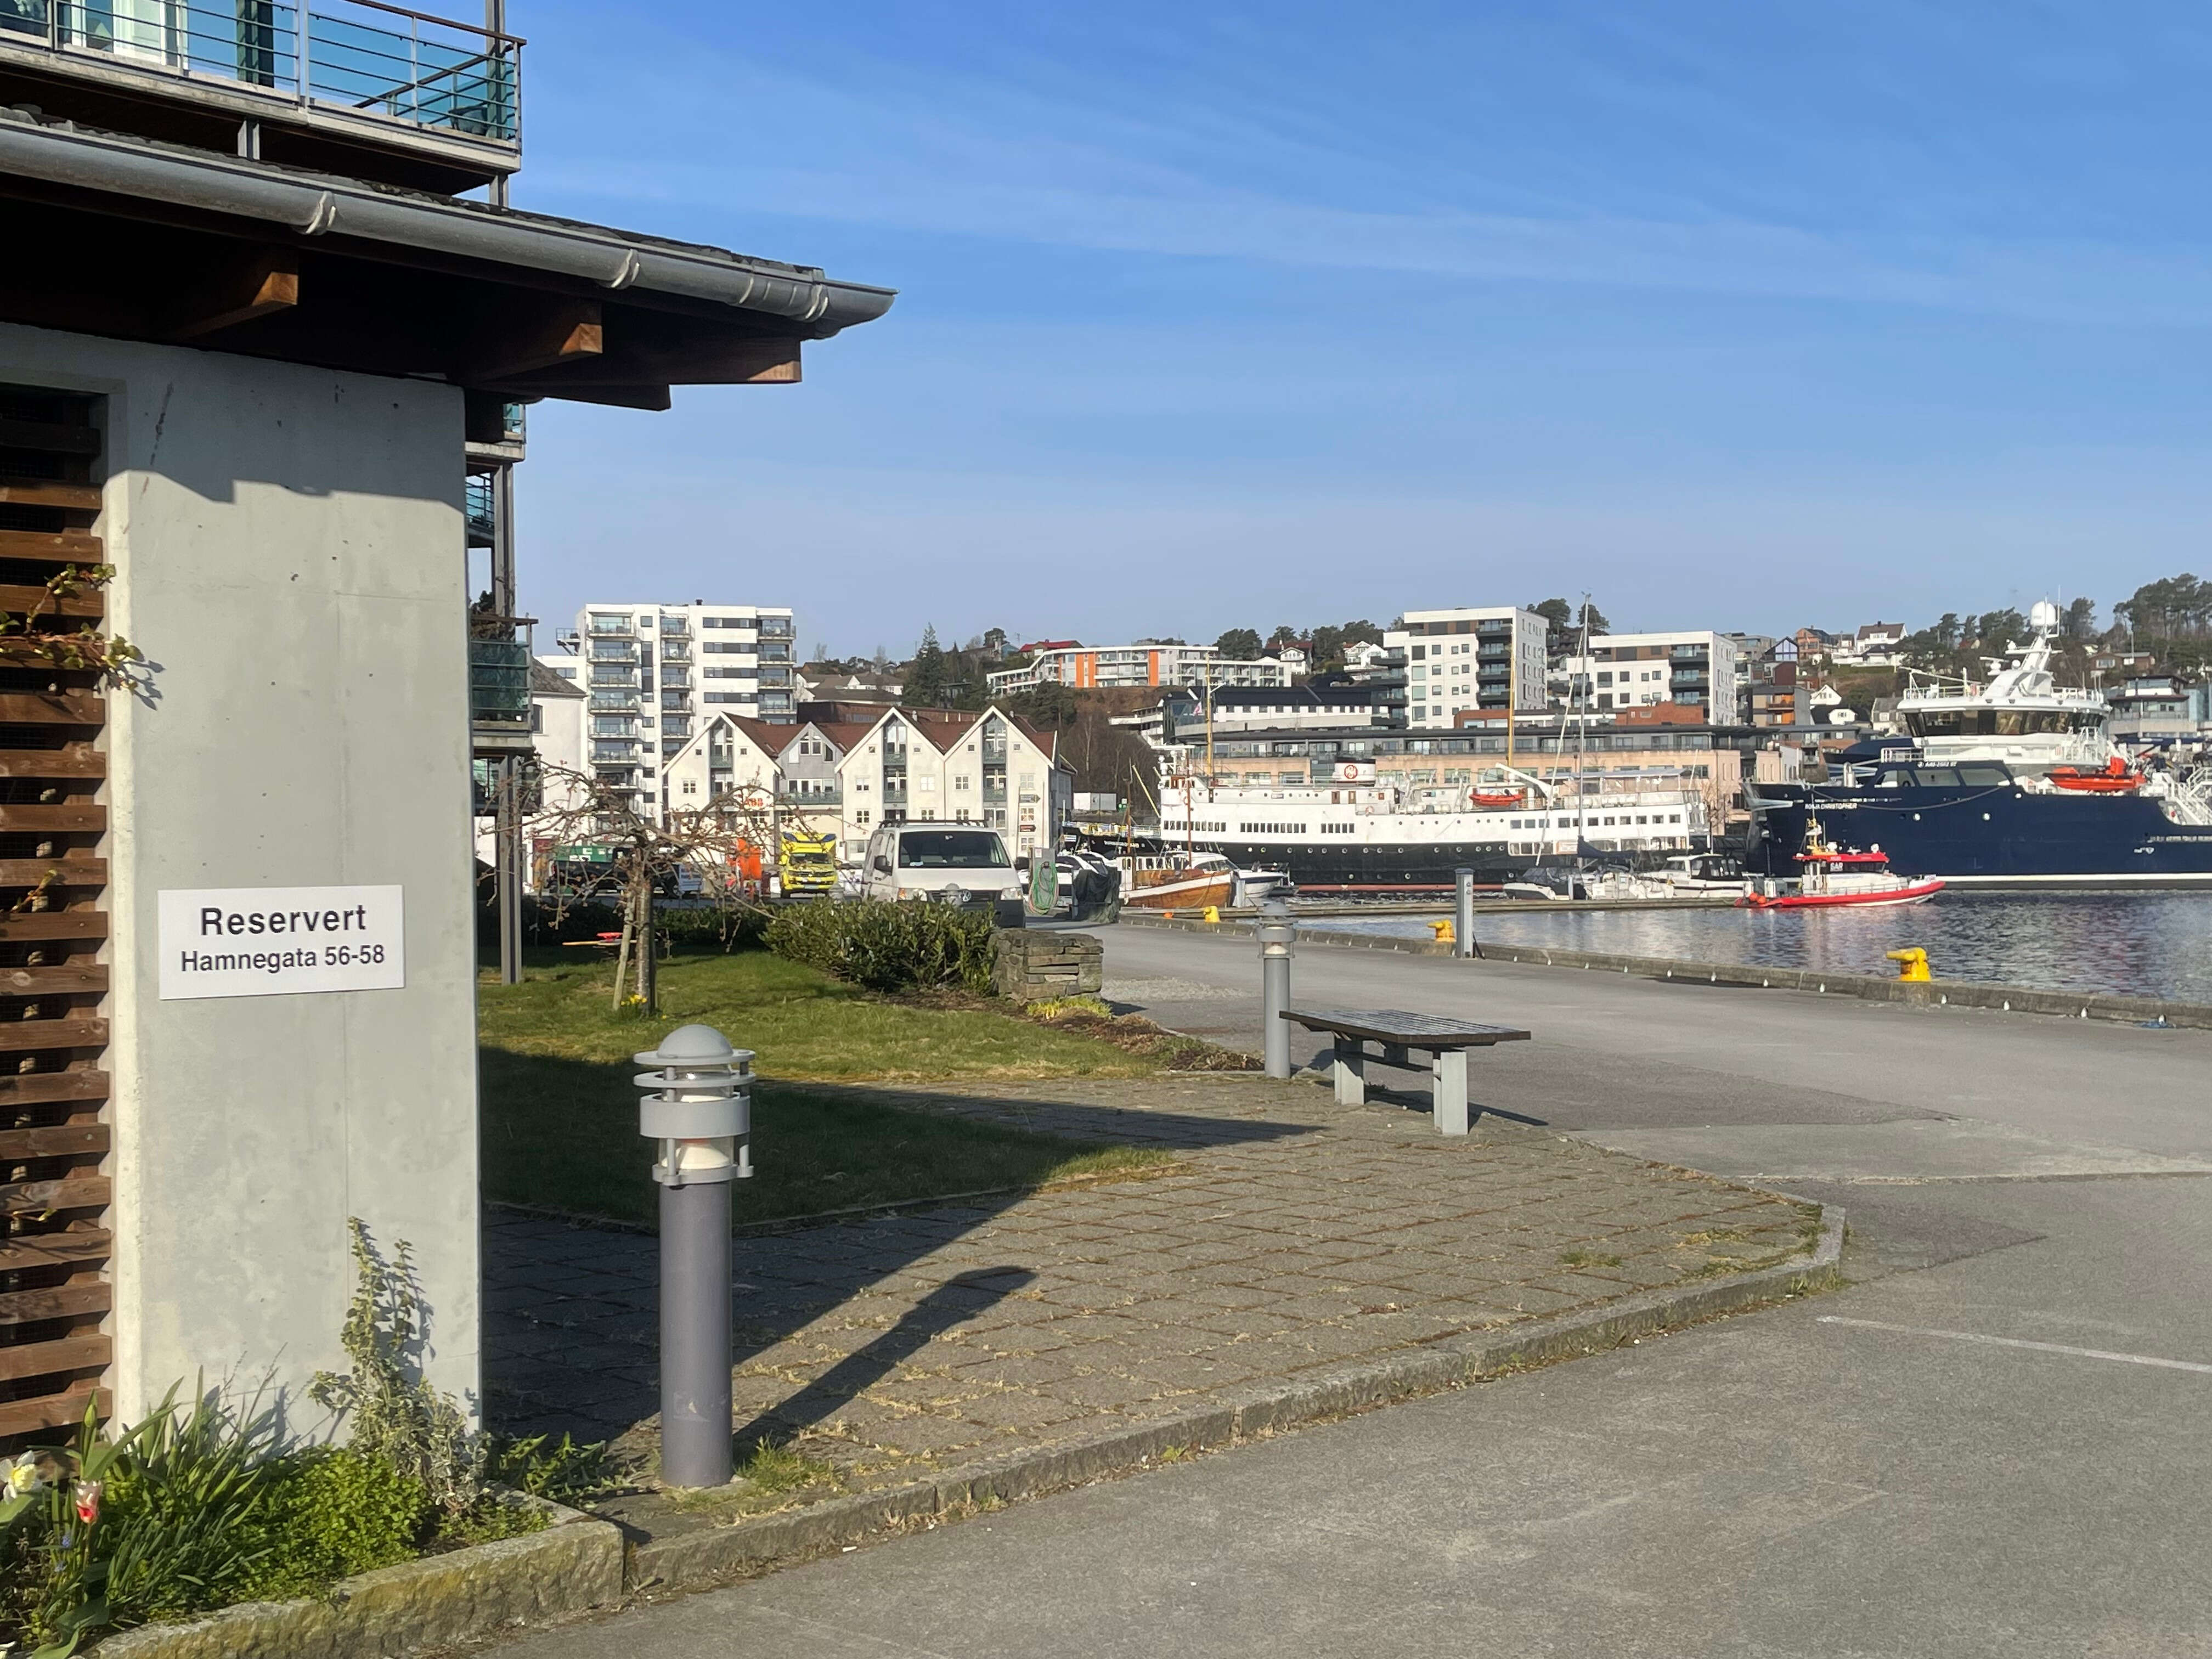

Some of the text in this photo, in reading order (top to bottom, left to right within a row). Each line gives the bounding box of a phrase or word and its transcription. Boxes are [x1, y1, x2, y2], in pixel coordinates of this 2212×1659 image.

[202, 905, 365, 935] Reservert
[182, 945, 383, 973] Hamnegata 56-58
